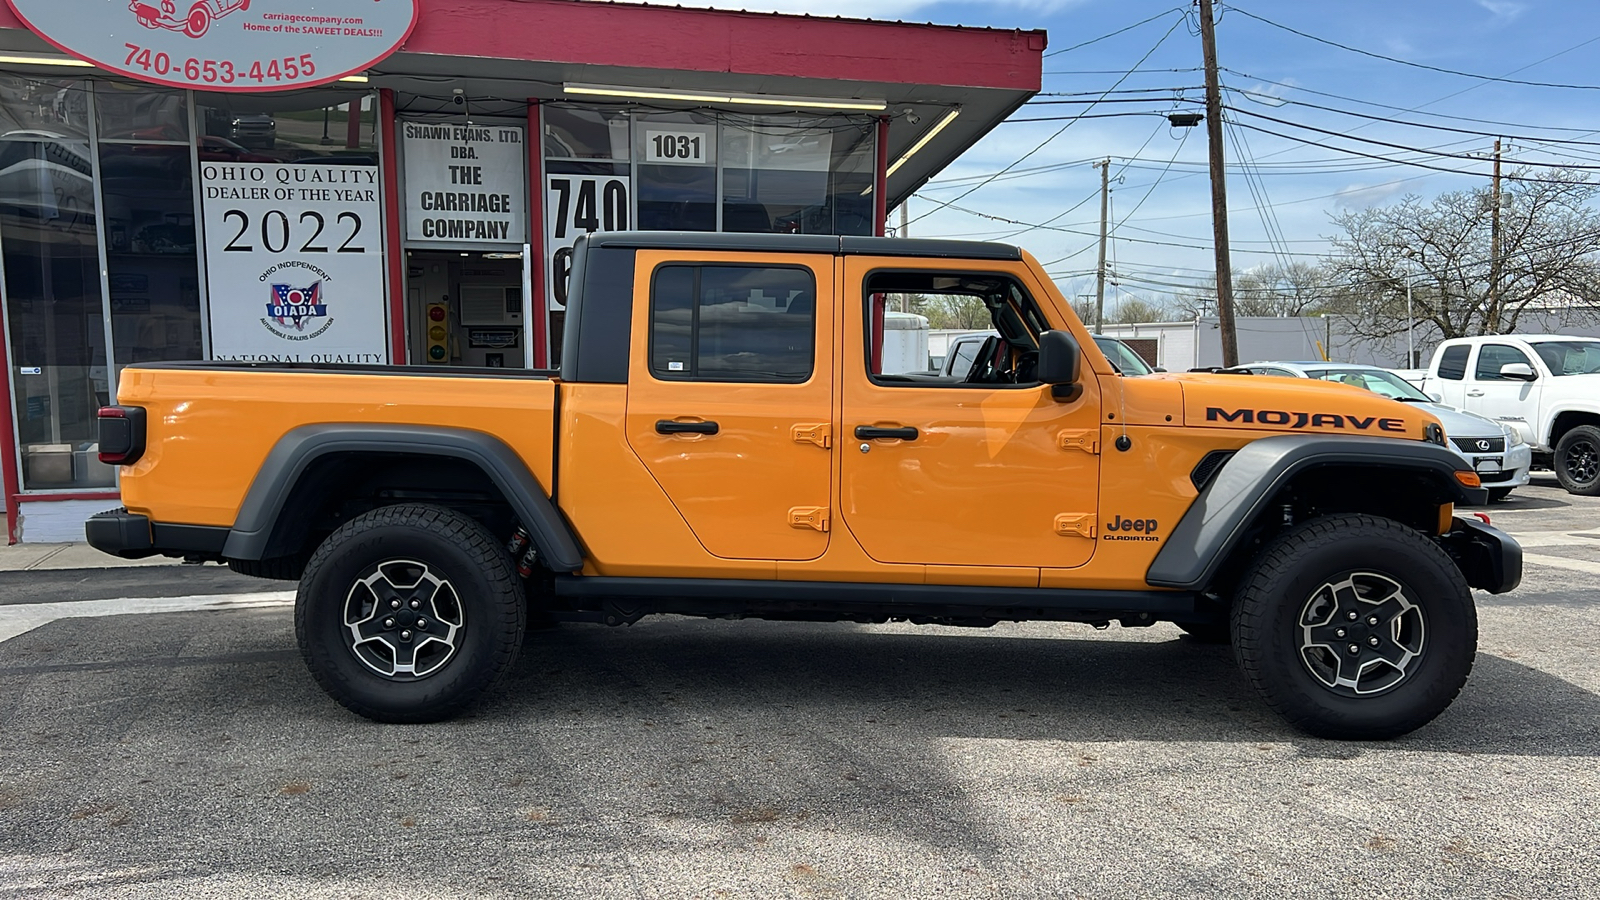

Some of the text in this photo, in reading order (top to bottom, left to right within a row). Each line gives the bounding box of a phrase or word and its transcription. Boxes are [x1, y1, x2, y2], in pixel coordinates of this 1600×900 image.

[263, 12, 363, 25] carriagecompany.com
[243, 22, 383, 37] Home of the SAWEET DEALS!!!
[123, 42, 316, 83] 740-653-4455
[406, 126, 450, 140] SHAWN
[498, 130, 521, 143] LTD.
[450, 146, 479, 160] DBA.
[652, 135, 700, 159] 1031
[203, 166, 377, 185] OHIO QUALITY
[449, 165, 482, 185] THE
[207, 186, 375, 202] DEALER OF THE YEAR
[421, 191, 511, 213] CARRIAGE
[551, 179, 628, 239] 740
[223, 209, 366, 253] 2022
[422, 218, 510, 240] COMPANY
[258, 260, 332, 283] OHIO INDEPENDENT
[274, 305, 318, 317] OIADA
[259, 317, 334, 342] AUTOMOBILE DEALERS ASSOCIATION
[1206, 407, 1406, 432] MOJAVE
[1106, 515, 1158, 534] Jeep
[1103, 534, 1159, 542] GLADIATOR
